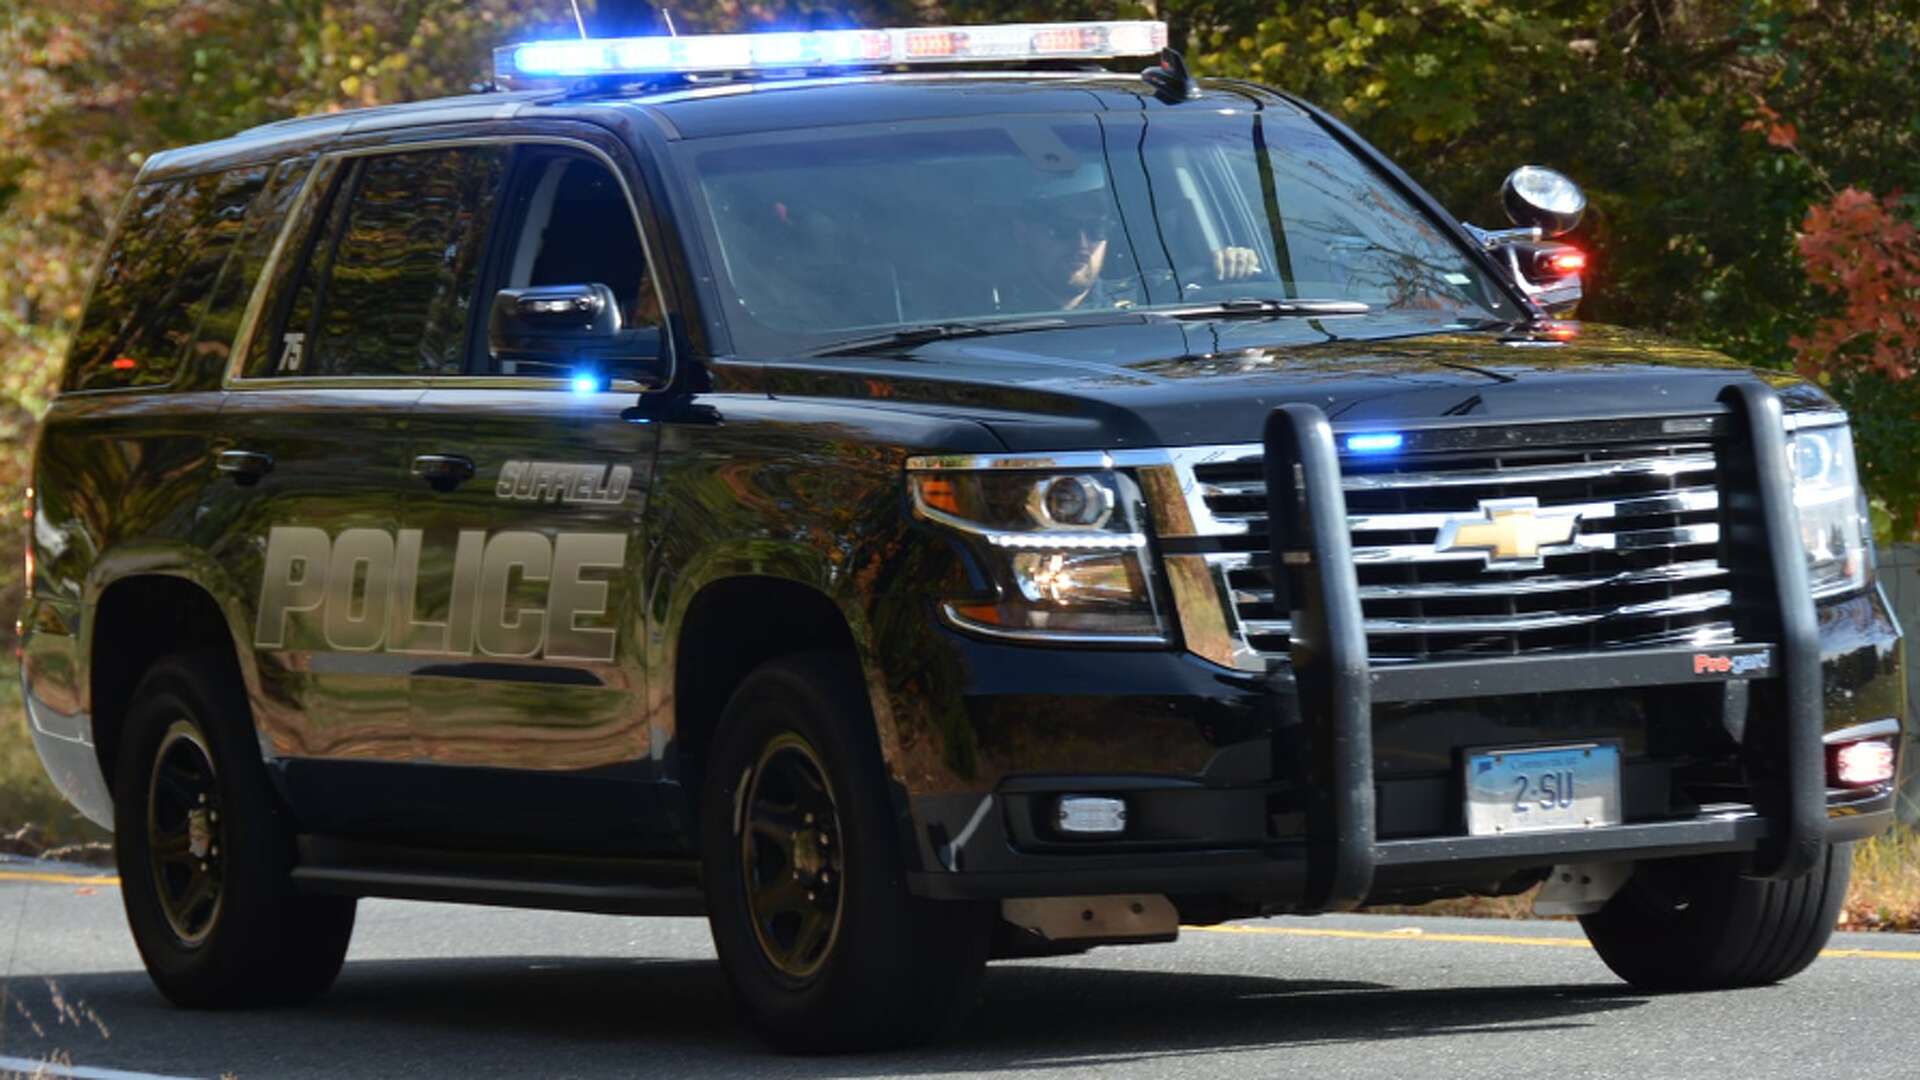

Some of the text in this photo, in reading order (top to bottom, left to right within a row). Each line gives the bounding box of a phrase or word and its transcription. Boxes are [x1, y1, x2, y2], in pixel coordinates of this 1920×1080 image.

[278, 333, 305, 370] 75
[496, 460, 632, 504] SUFFIELD
[255, 526, 628, 662] POLICE
[1512, 770, 1575, 813] 2-SU
